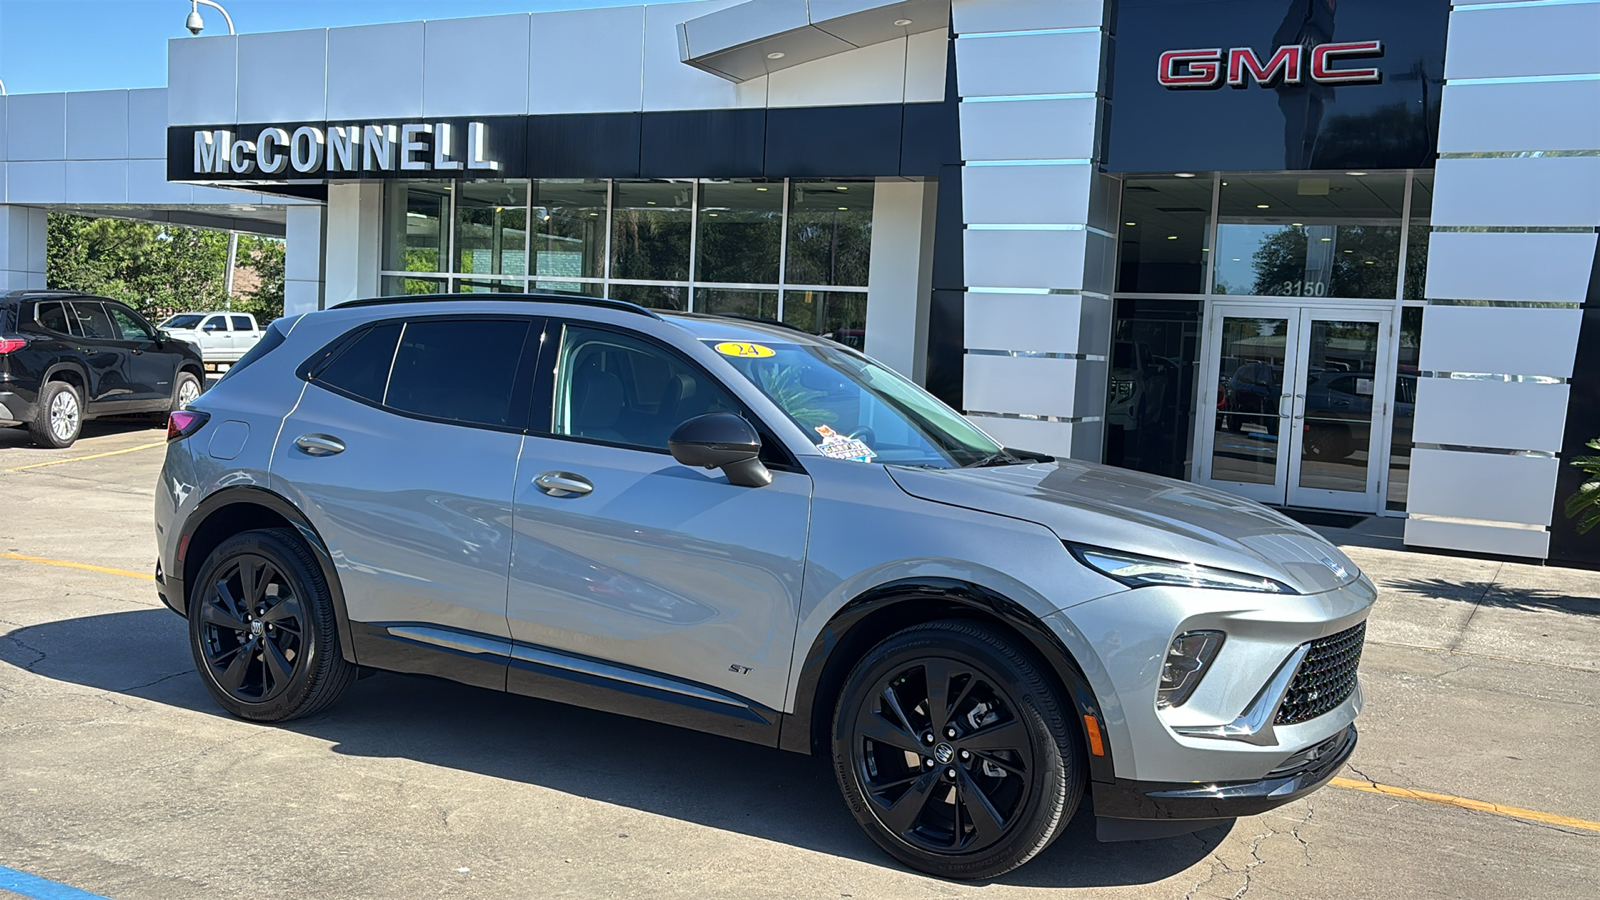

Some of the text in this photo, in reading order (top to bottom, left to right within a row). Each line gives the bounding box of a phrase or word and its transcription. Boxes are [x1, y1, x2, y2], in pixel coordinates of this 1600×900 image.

[1157, 40, 1383, 88] GMC
[193, 122, 499, 174] McCONNELL
[1283, 280, 1325, 296] 3150
[732, 343, 759, 355] 24
[728, 663, 754, 675] ST
